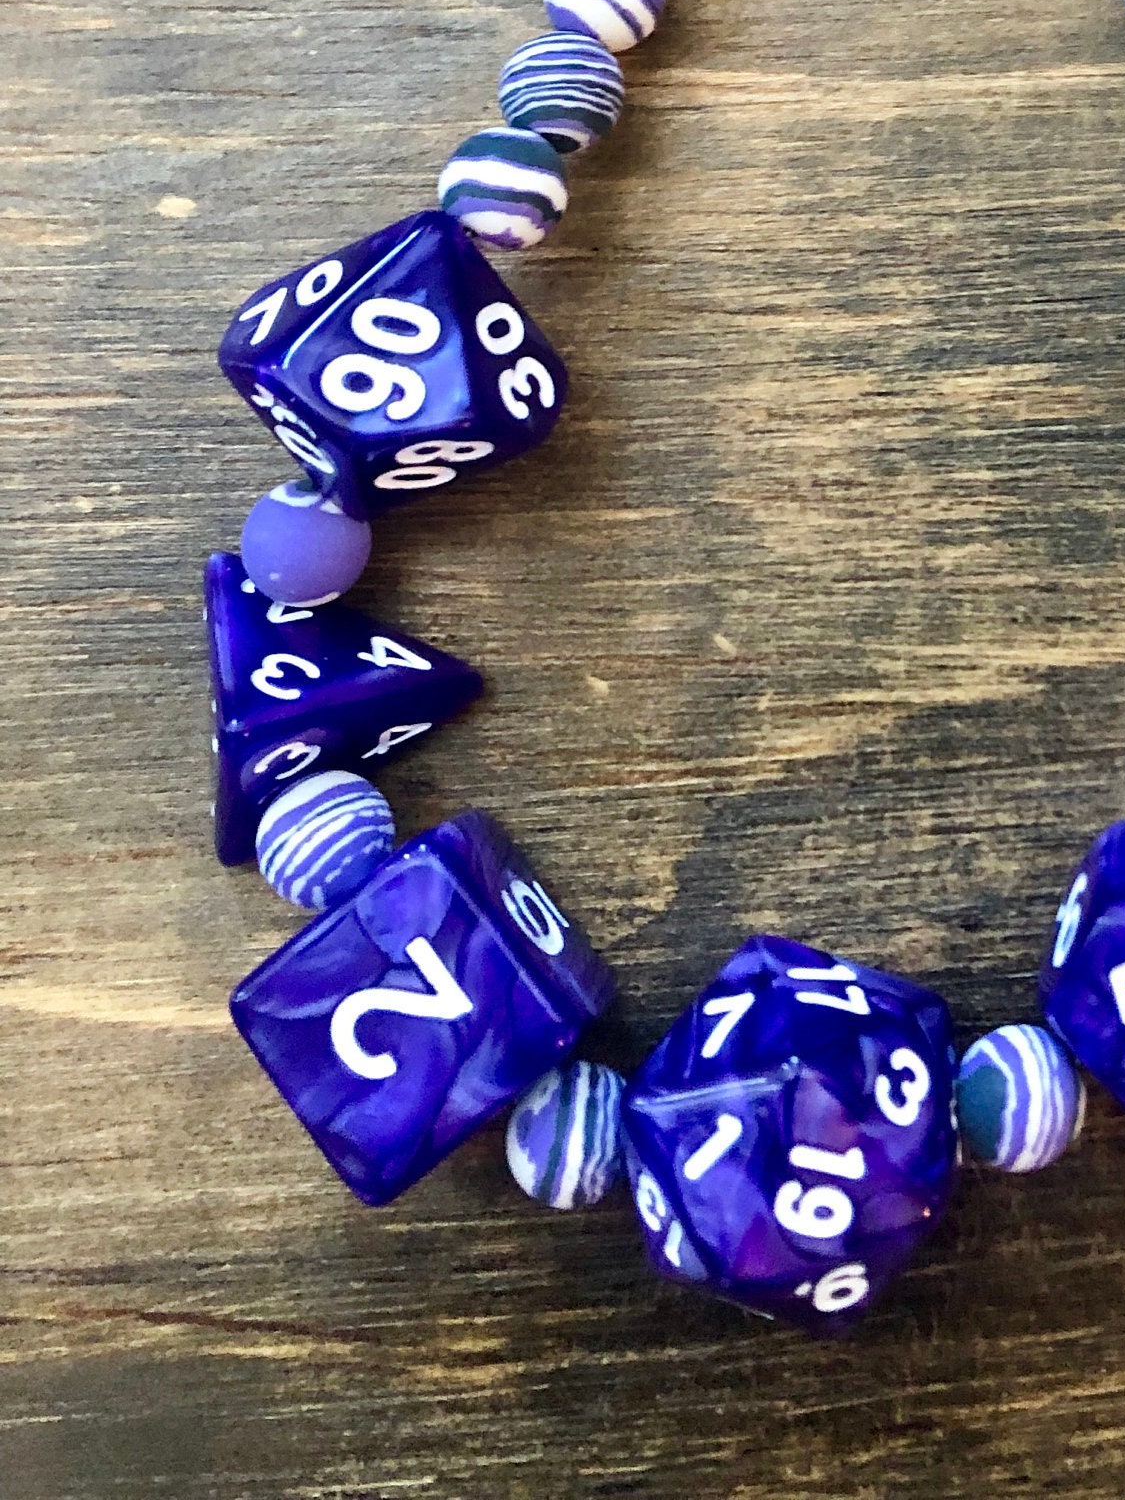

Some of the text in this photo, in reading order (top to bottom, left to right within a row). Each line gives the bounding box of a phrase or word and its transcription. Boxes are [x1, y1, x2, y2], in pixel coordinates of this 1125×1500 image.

[474, 300, 556, 421] 30
[373, 439, 495, 490] 80
[249, 652, 322, 702] 3
[356, 635, 433, 672] 4
[329, 936, 474, 1080] 2
[873, 1046, 931, 1128] 3
